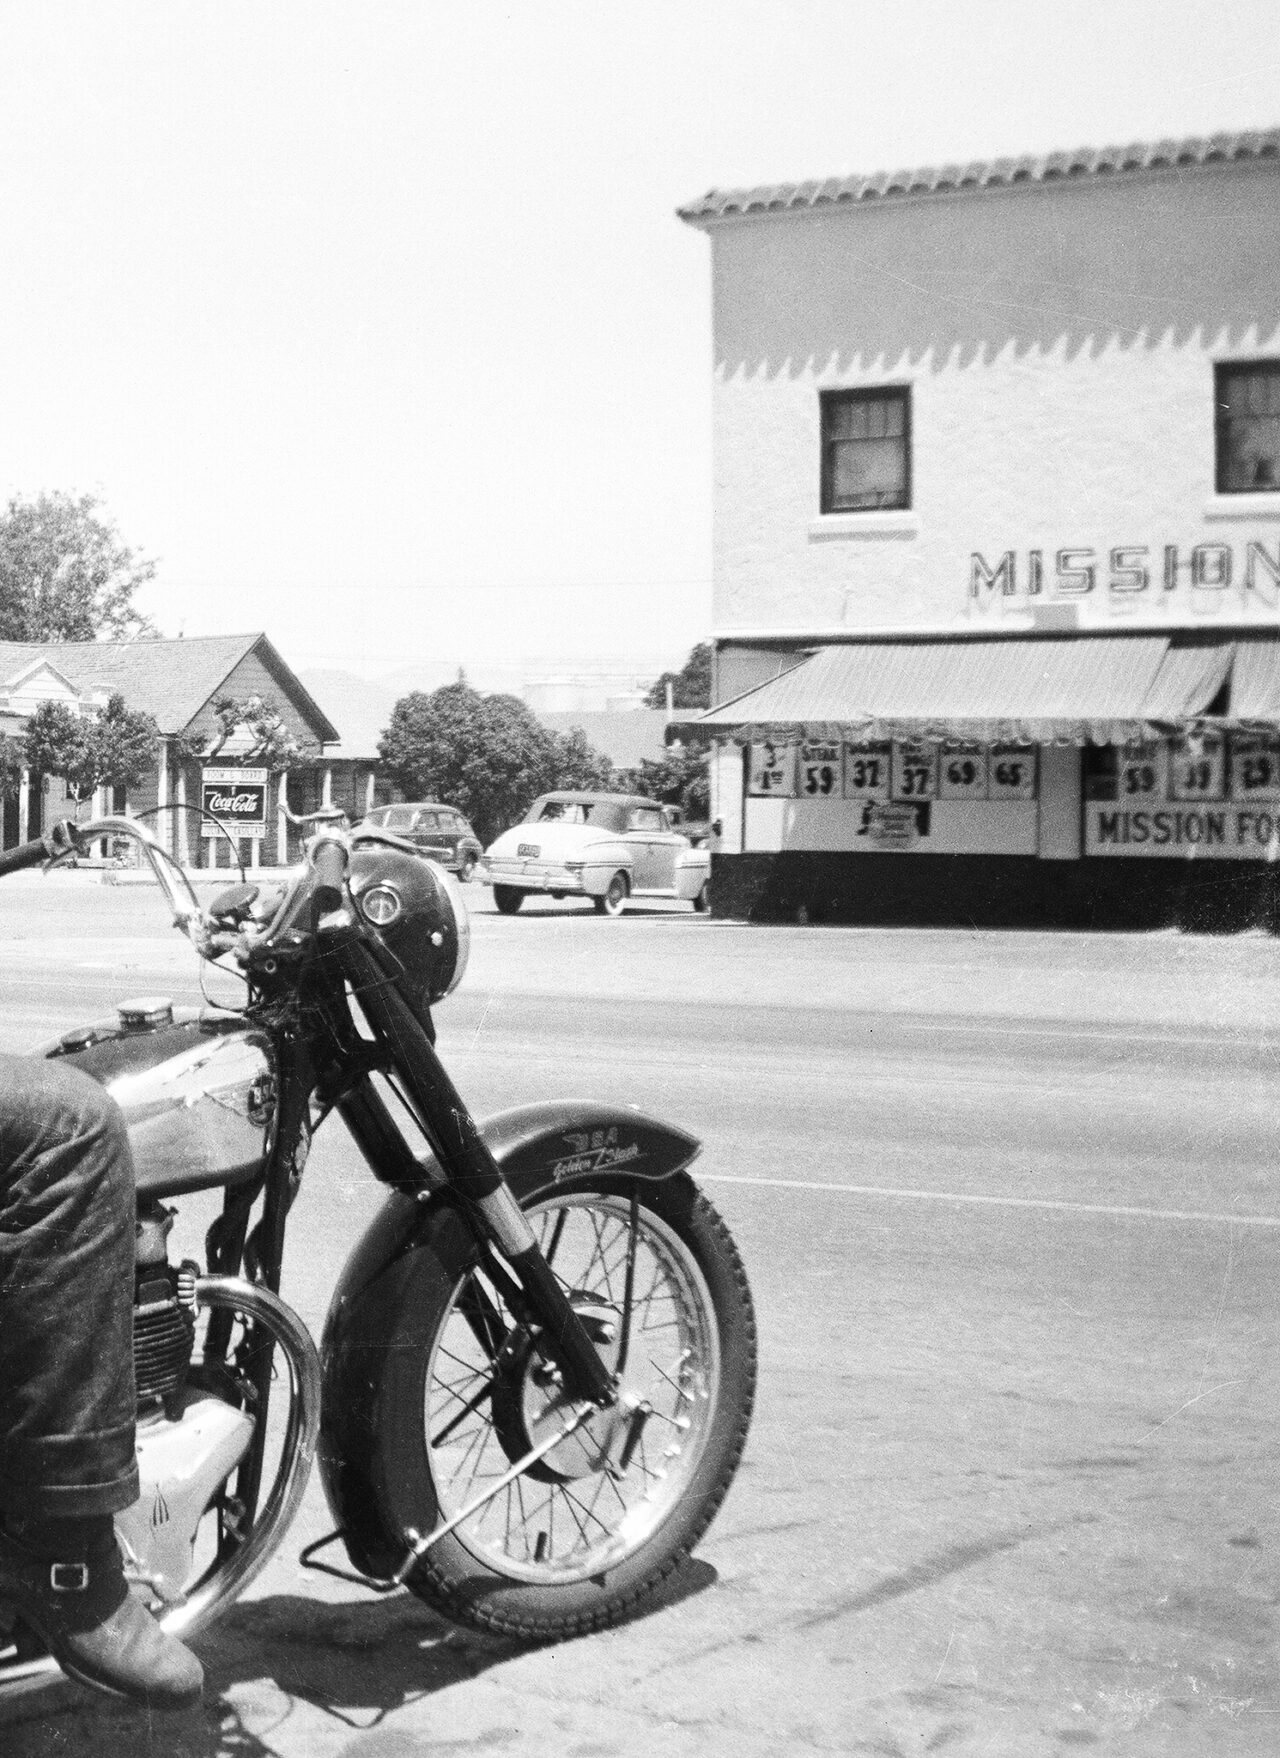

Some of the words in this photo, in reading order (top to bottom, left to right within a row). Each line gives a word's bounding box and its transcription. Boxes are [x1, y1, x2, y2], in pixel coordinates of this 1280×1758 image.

[970, 541, 1280, 597] MISSION
[805, 766, 833, 794] 59
[902, 768, 929, 795] 37
[947, 761, 975, 784] 69
[995, 762, 1022, 786] 65
[1098, 812, 1224, 844] MISSION
[1238, 812, 1280, 844] FO
